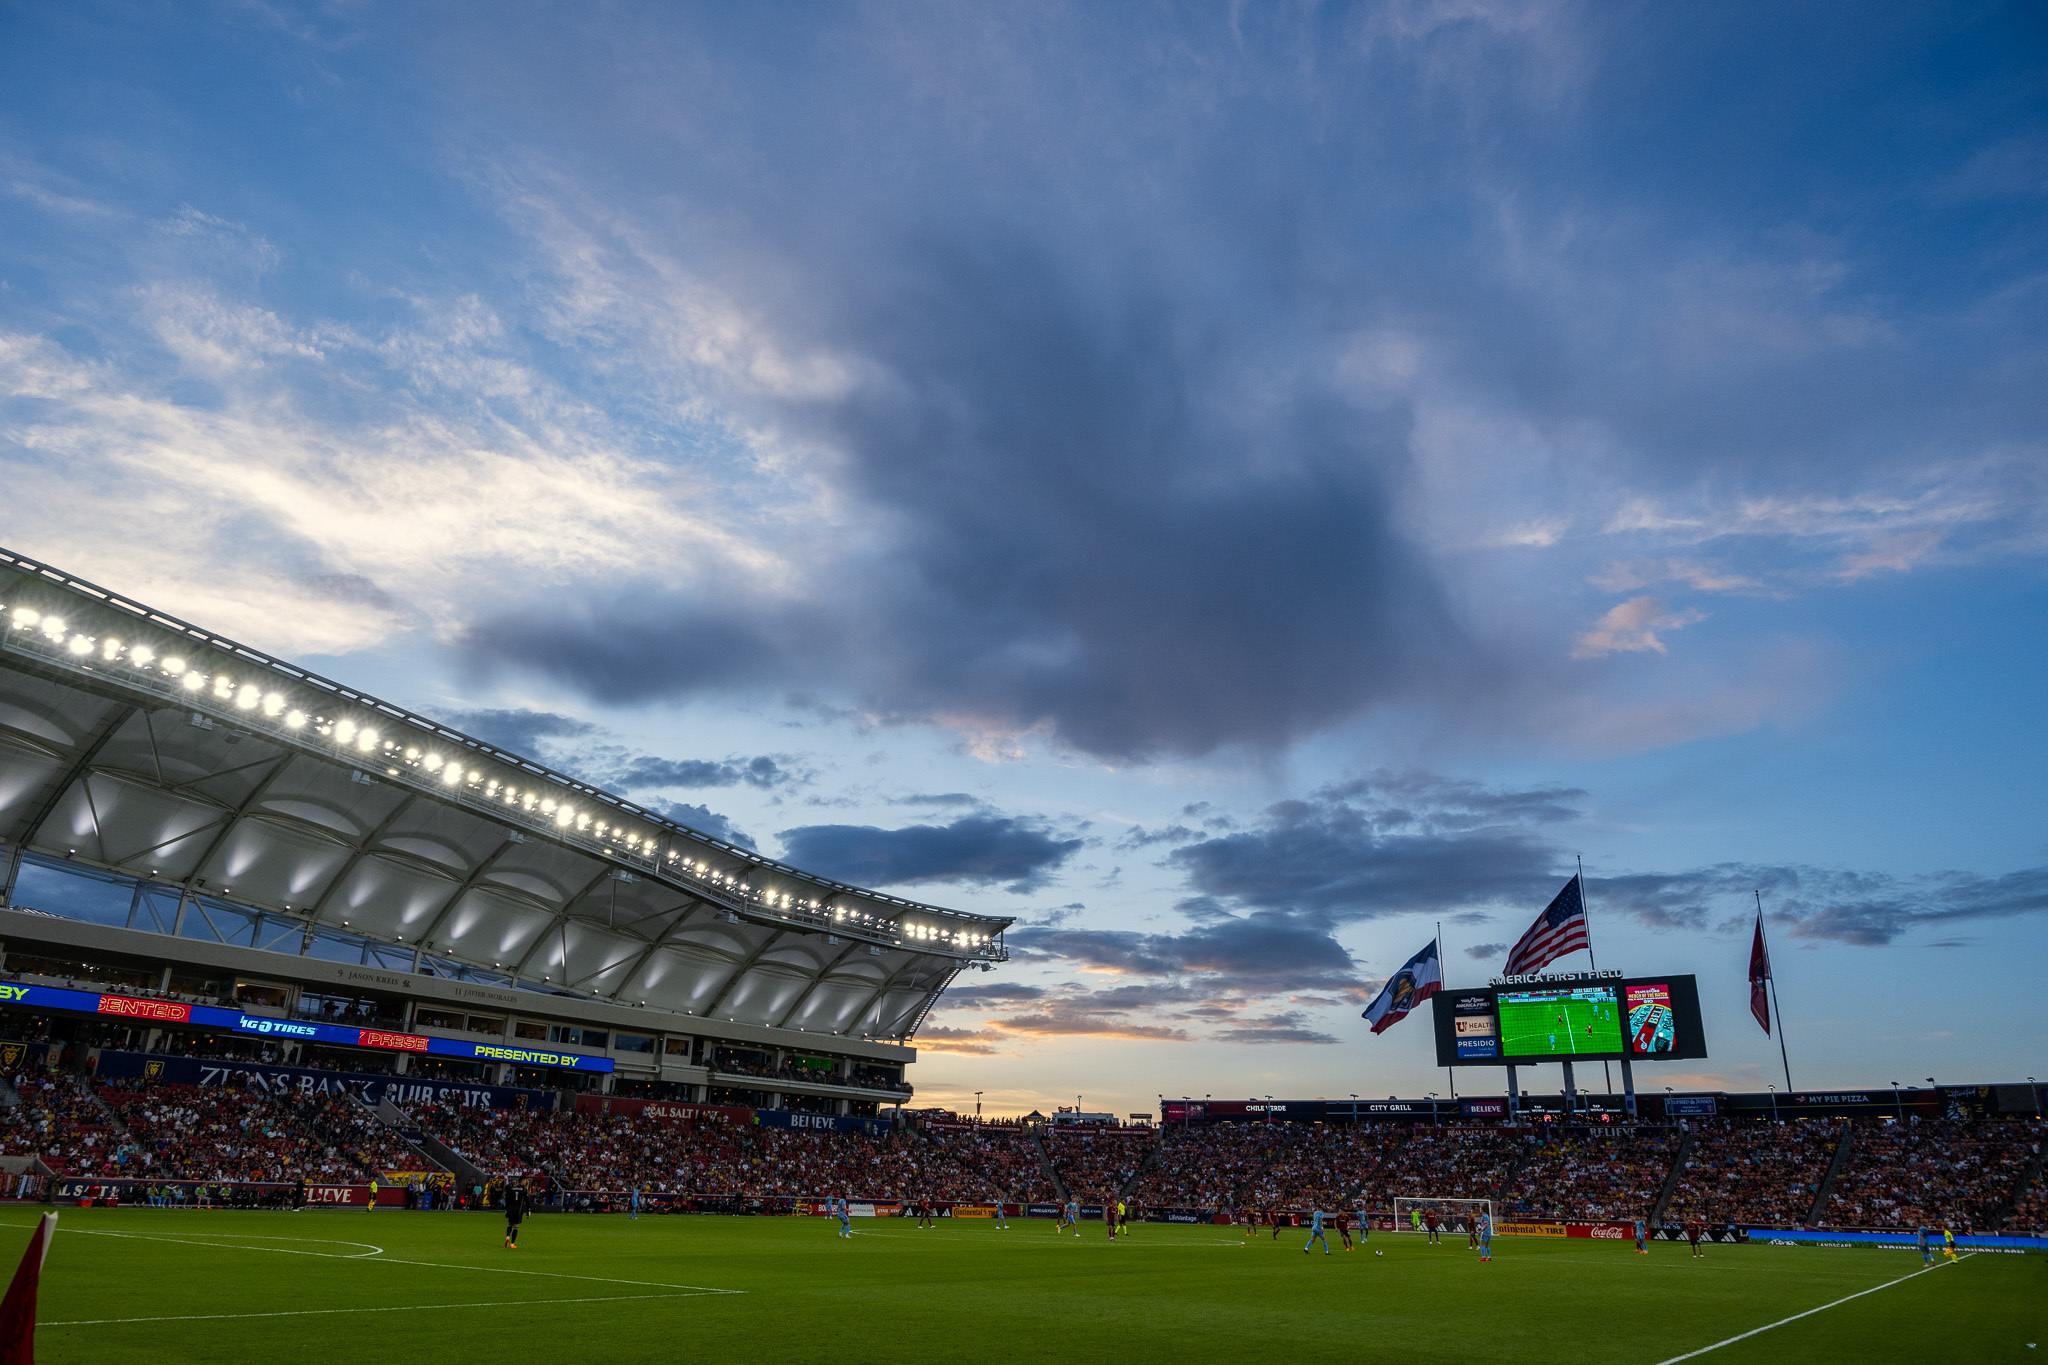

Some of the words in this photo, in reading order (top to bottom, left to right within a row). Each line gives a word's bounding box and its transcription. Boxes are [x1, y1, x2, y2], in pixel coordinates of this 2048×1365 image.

[337, 969, 343, 977] 9
[348, 971, 374, 982] JASON
[375, 975, 399, 985] KREIS
[1488, 974, 1540, 986] AMERICA
[1546, 972, 1583, 982] FIRST
[1588, 969, 1623, 979] FIELD
[463, 989, 487, 998] JAVIER
[487, 992, 517, 1003] MORALES
[273, 1023, 316, 1036] TIRES
[367, 1032, 428, 1051] PRESE
[474, 1045, 558, 1065] PRESENTED
[560, 1056, 579, 1067] BY
[669, 1107, 693, 1119] SALT
[1470, 1105, 1502, 1113] BELIEVE
[953, 1207, 983, 1217] Continental
[1168, 1214, 1197, 1222] LifeVantage
